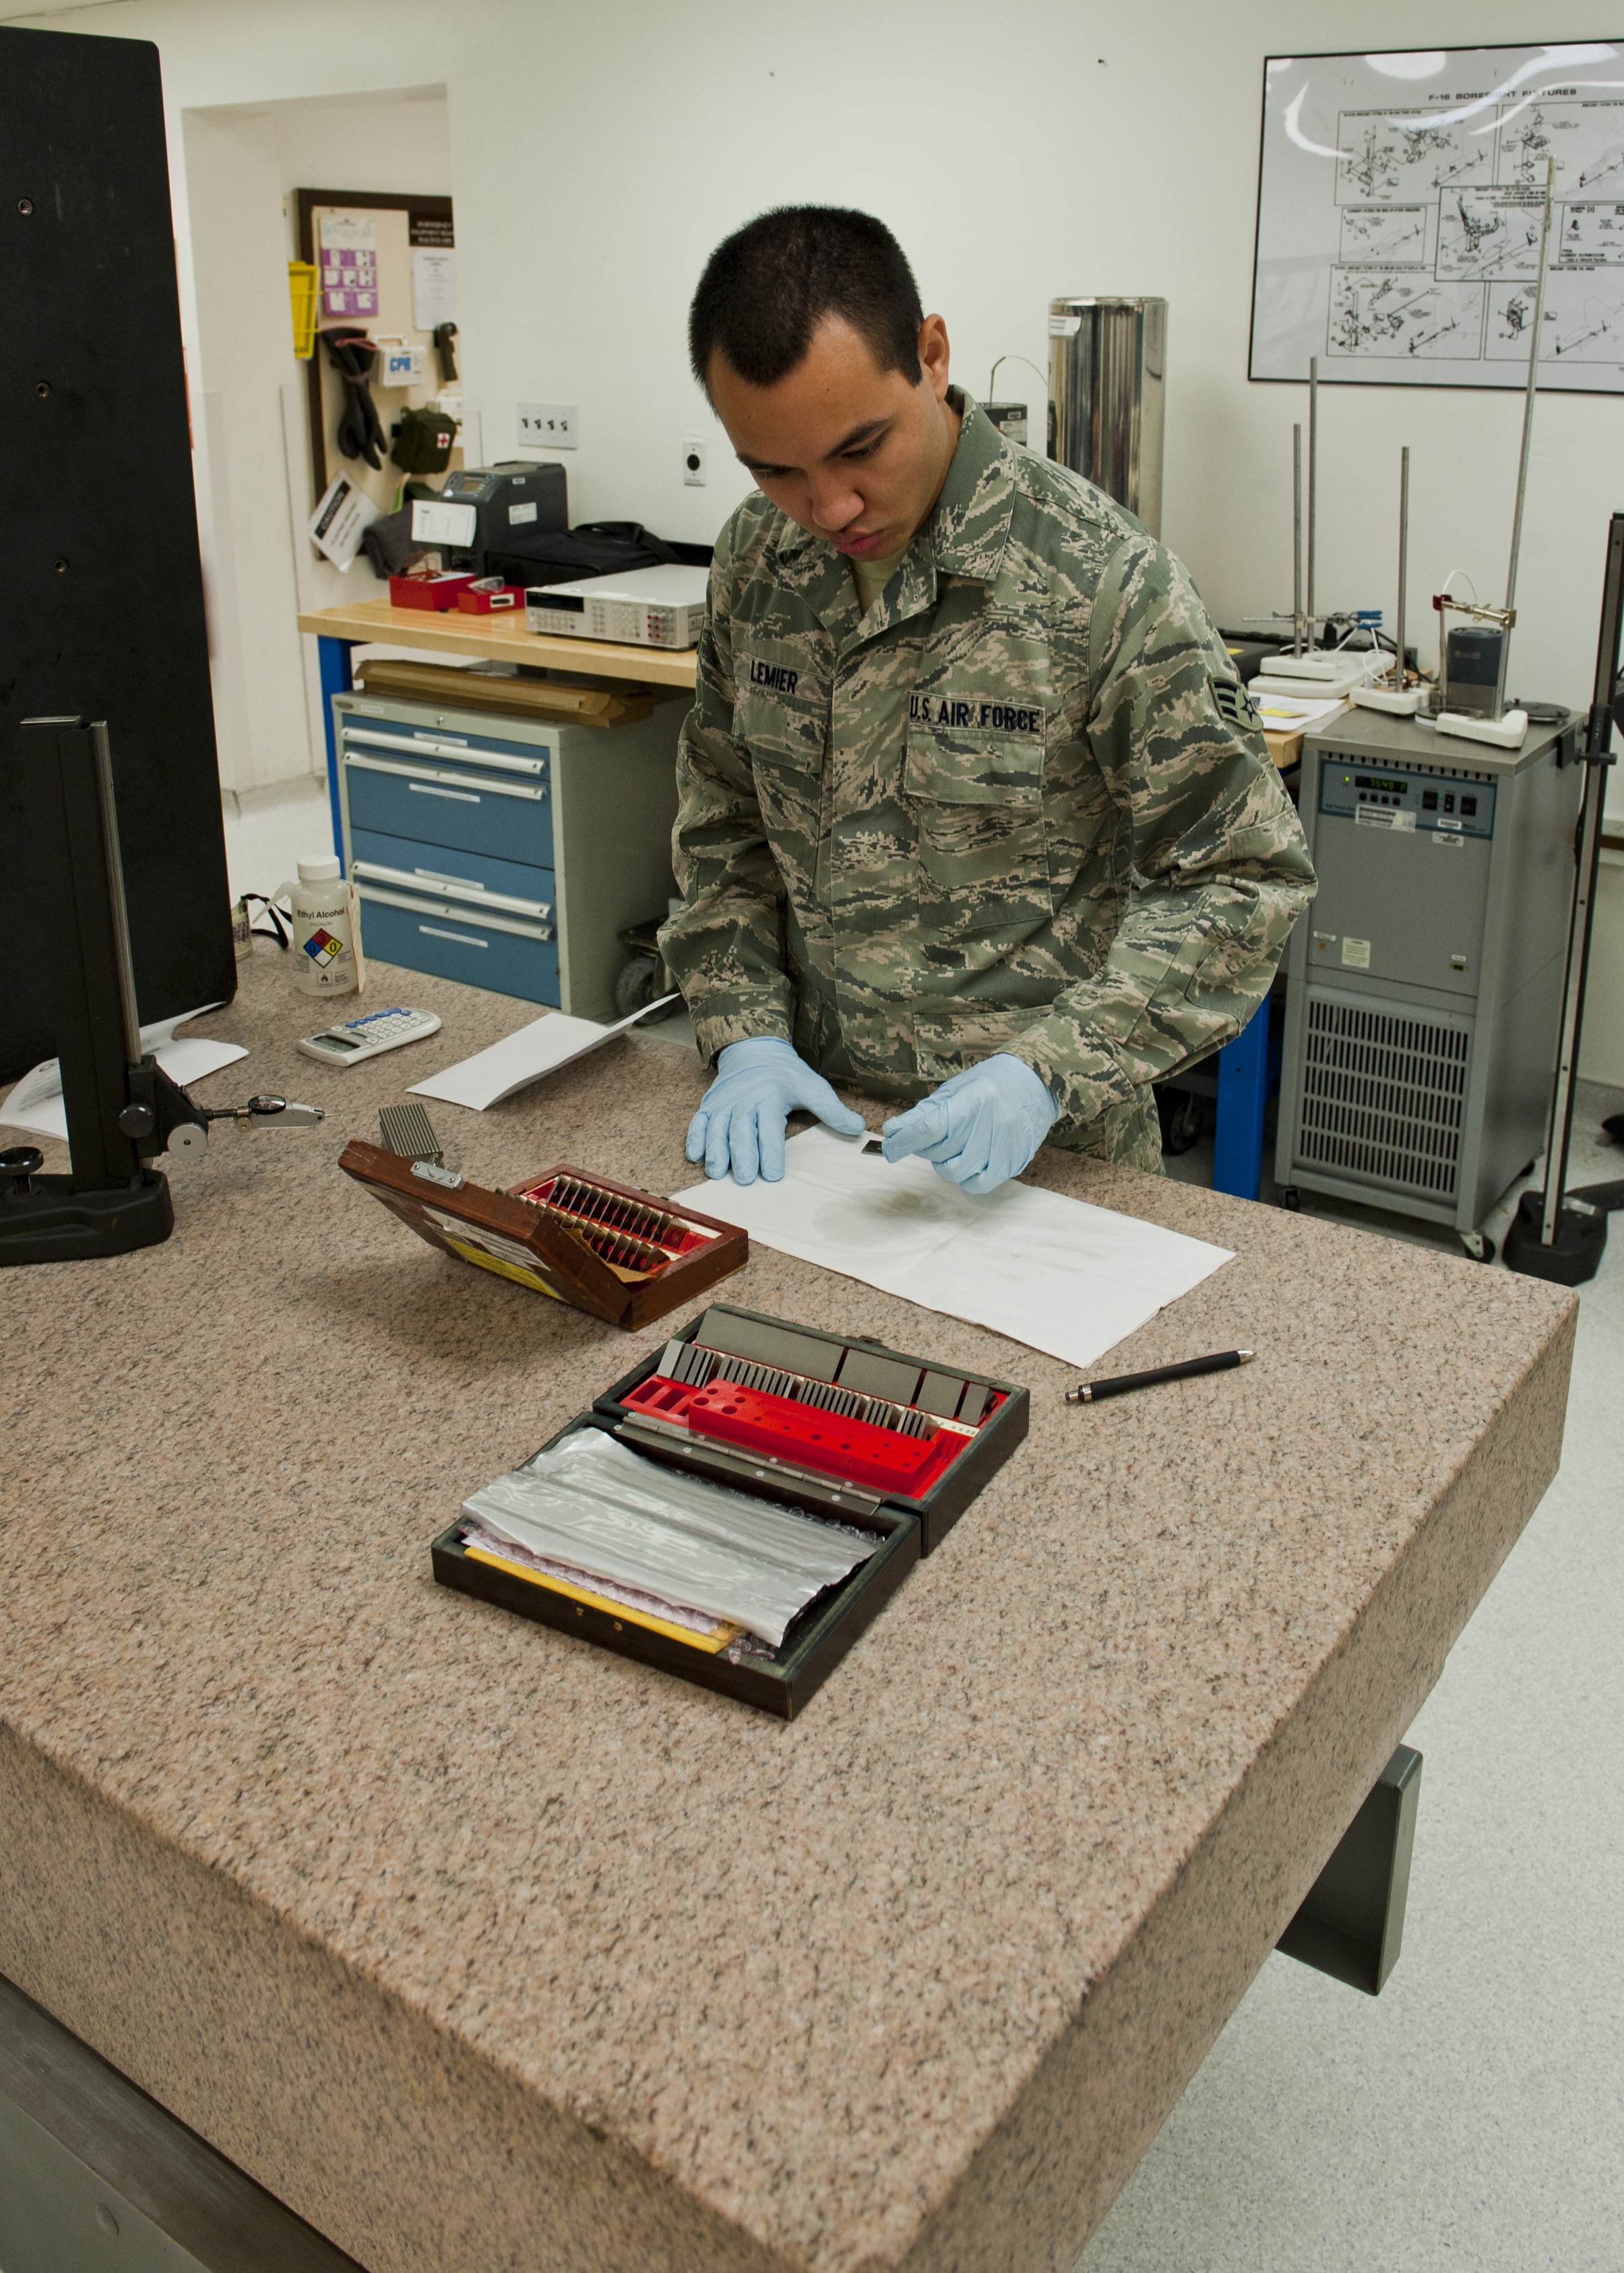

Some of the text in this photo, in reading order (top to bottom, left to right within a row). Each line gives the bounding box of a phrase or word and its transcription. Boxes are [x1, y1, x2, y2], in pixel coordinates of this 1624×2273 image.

[390, 357, 411, 371] CPR
[320, 490, 345, 530] CAUTION
[750, 660, 798, 694] LEMIER
[910, 695, 1040, 732] U.S. AIR FORCE
[297, 907, 344, 920] Ethyl Alcohol
[318, 934, 325, 944] 3
[309, 942, 337, 953] 0 0
